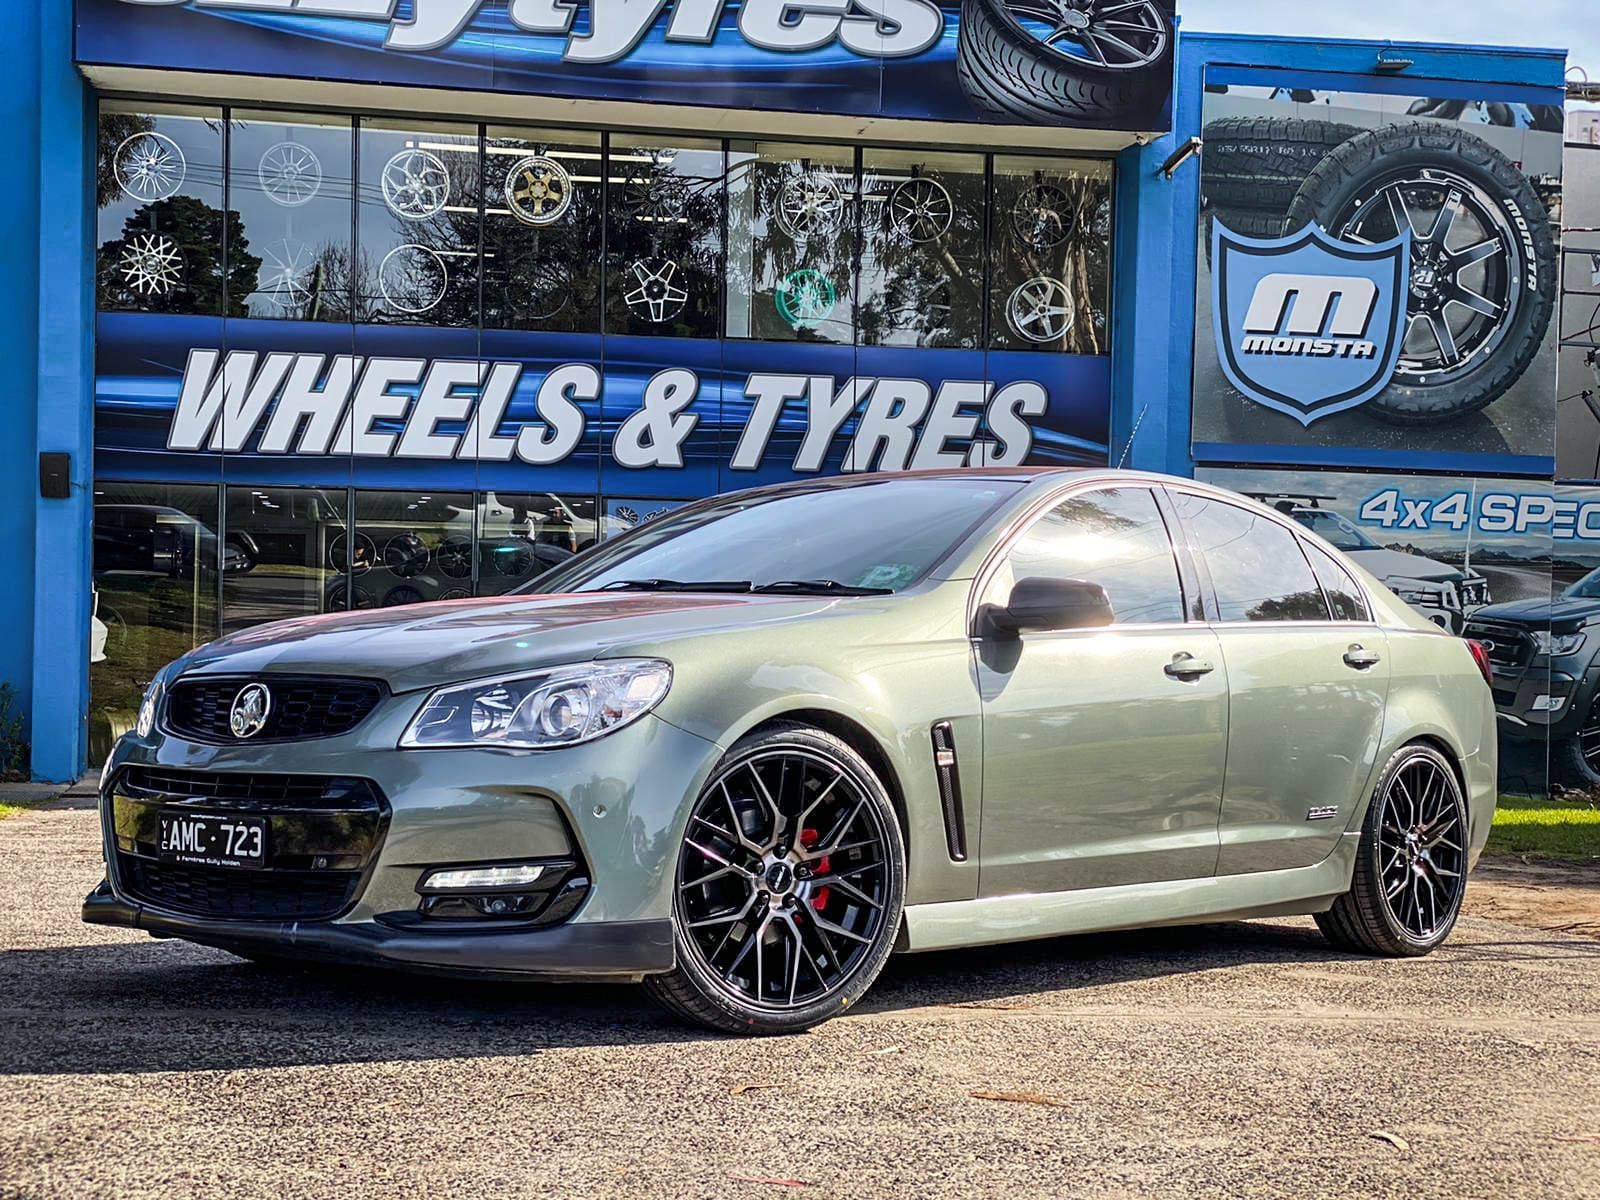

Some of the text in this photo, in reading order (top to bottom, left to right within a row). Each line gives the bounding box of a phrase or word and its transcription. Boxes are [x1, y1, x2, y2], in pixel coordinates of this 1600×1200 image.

[1503, 198, 1537, 292] MONSTA
[1241, 335, 1375, 358] MONSTA
[167, 348, 1048, 472] WHEELS & TYRES
[1360, 489, 1470, 530] 4x4
[161, 820, 169, 850] VIC
[169, 820, 262, 857] AMC 723
